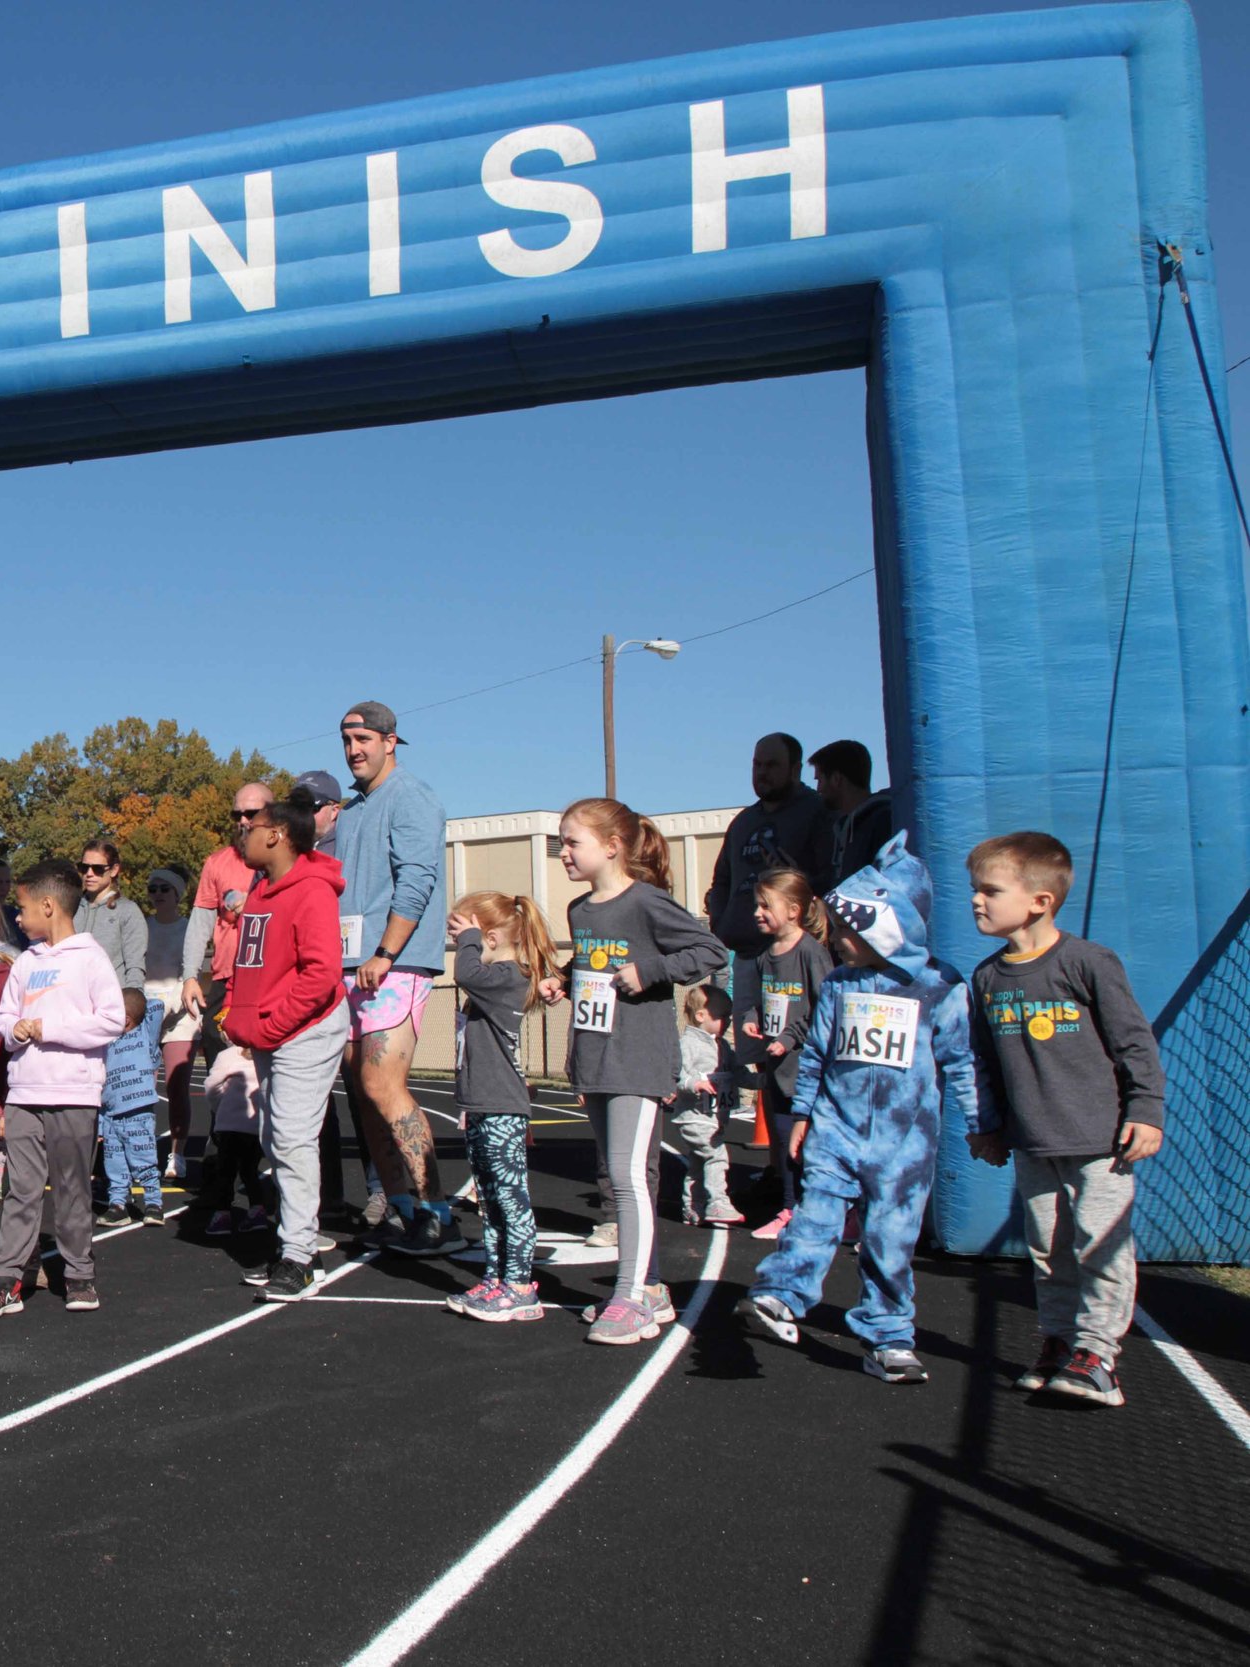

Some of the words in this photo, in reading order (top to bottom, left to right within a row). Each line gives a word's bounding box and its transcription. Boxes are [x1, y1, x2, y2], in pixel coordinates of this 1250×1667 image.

[236, 912, 272, 967] H
[27, 970, 61, 990] NIKE
[1056, 1024, 1080, 1033] 2021
[836, 1025, 906, 1061] DASH
